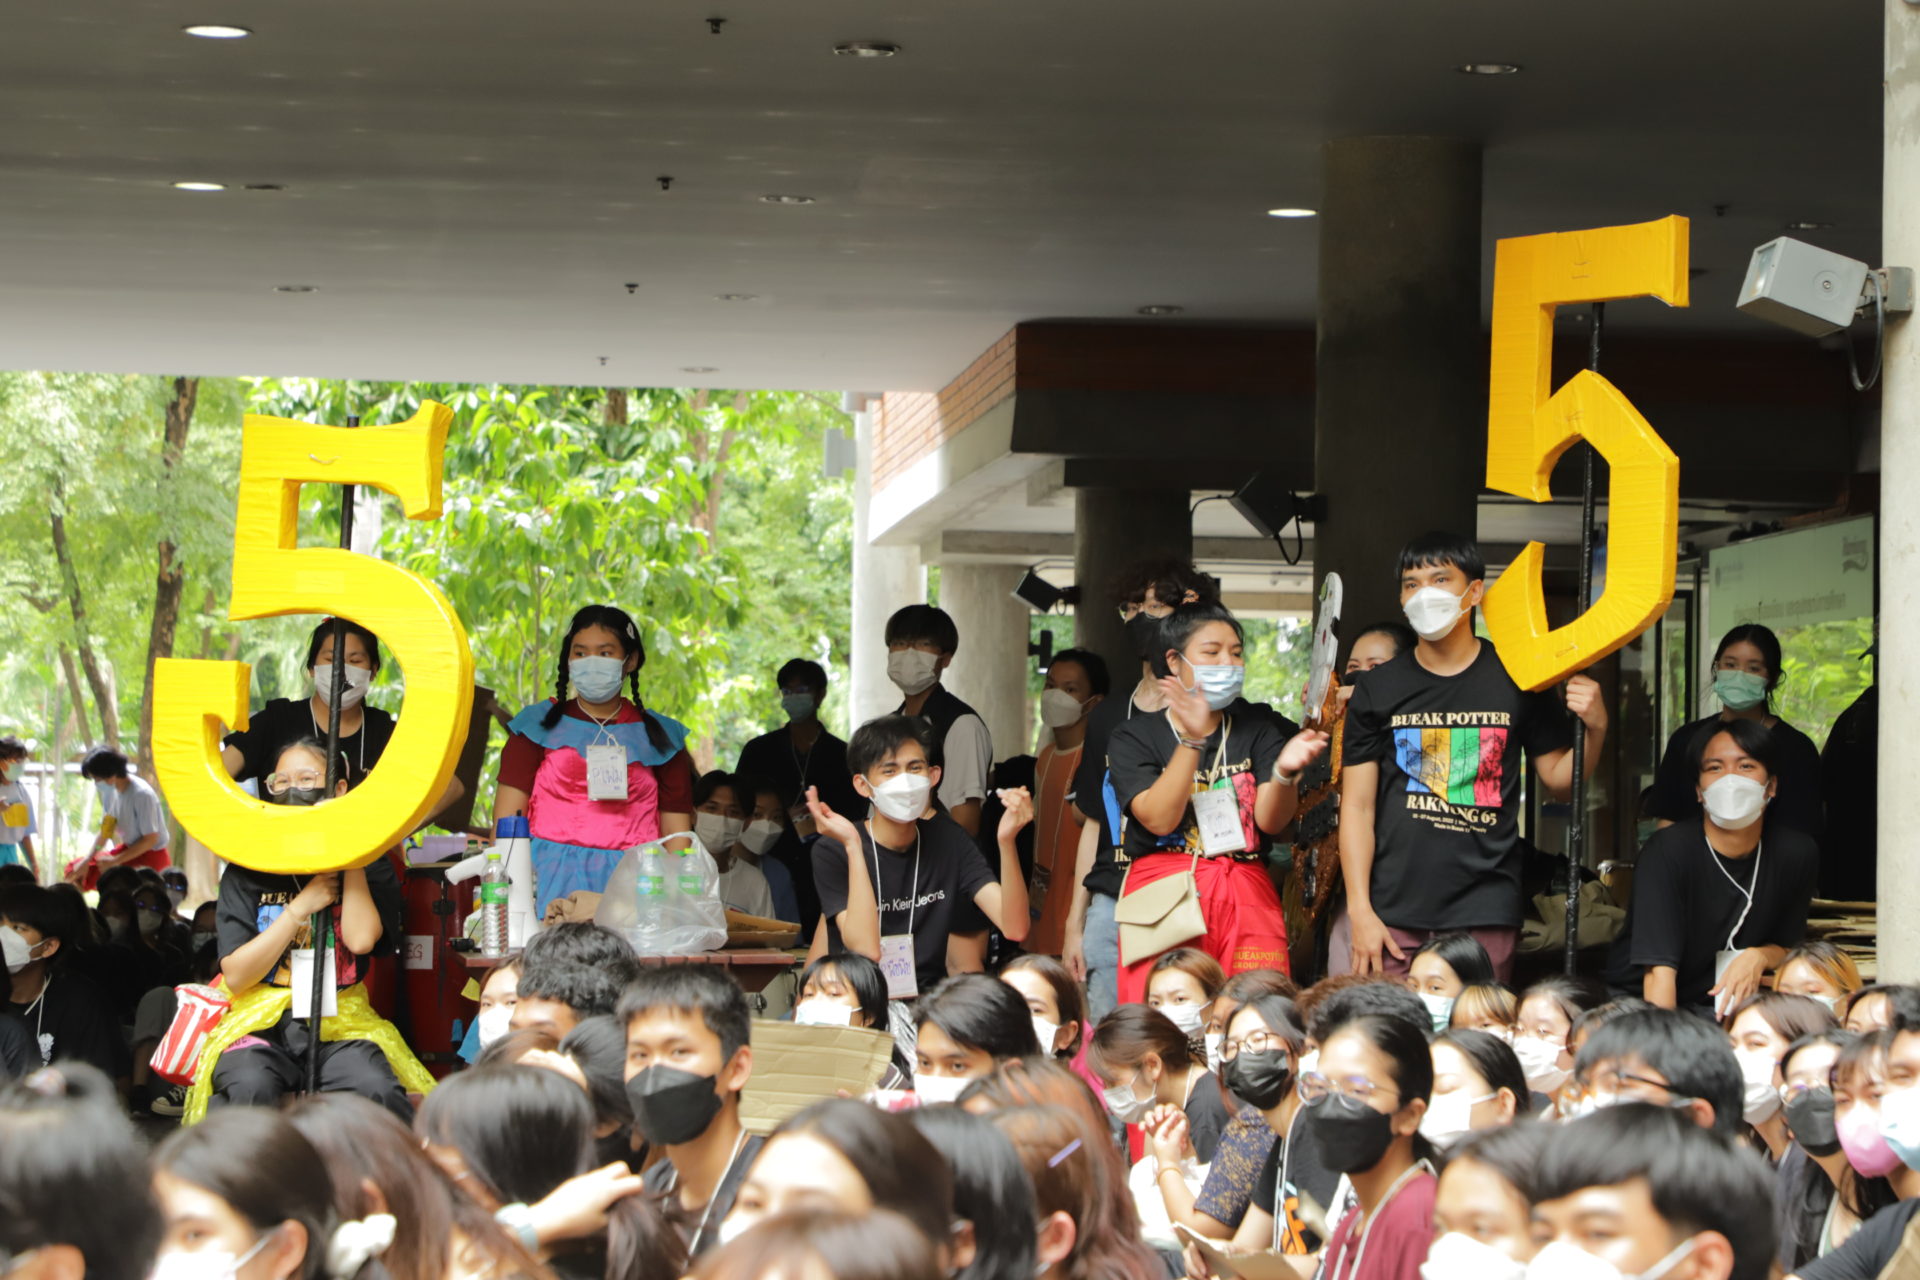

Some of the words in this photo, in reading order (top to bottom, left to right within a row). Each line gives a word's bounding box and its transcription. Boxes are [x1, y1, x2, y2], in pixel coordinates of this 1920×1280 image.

[1481, 214, 1690, 691] 5
[151, 399, 475, 874] 5
[1391, 712, 1443, 727] BUEAK
[1446, 711, 1511, 726] POTTER
[1481, 810, 1498, 827] 65
[915, 889, 946, 907] Jeans
